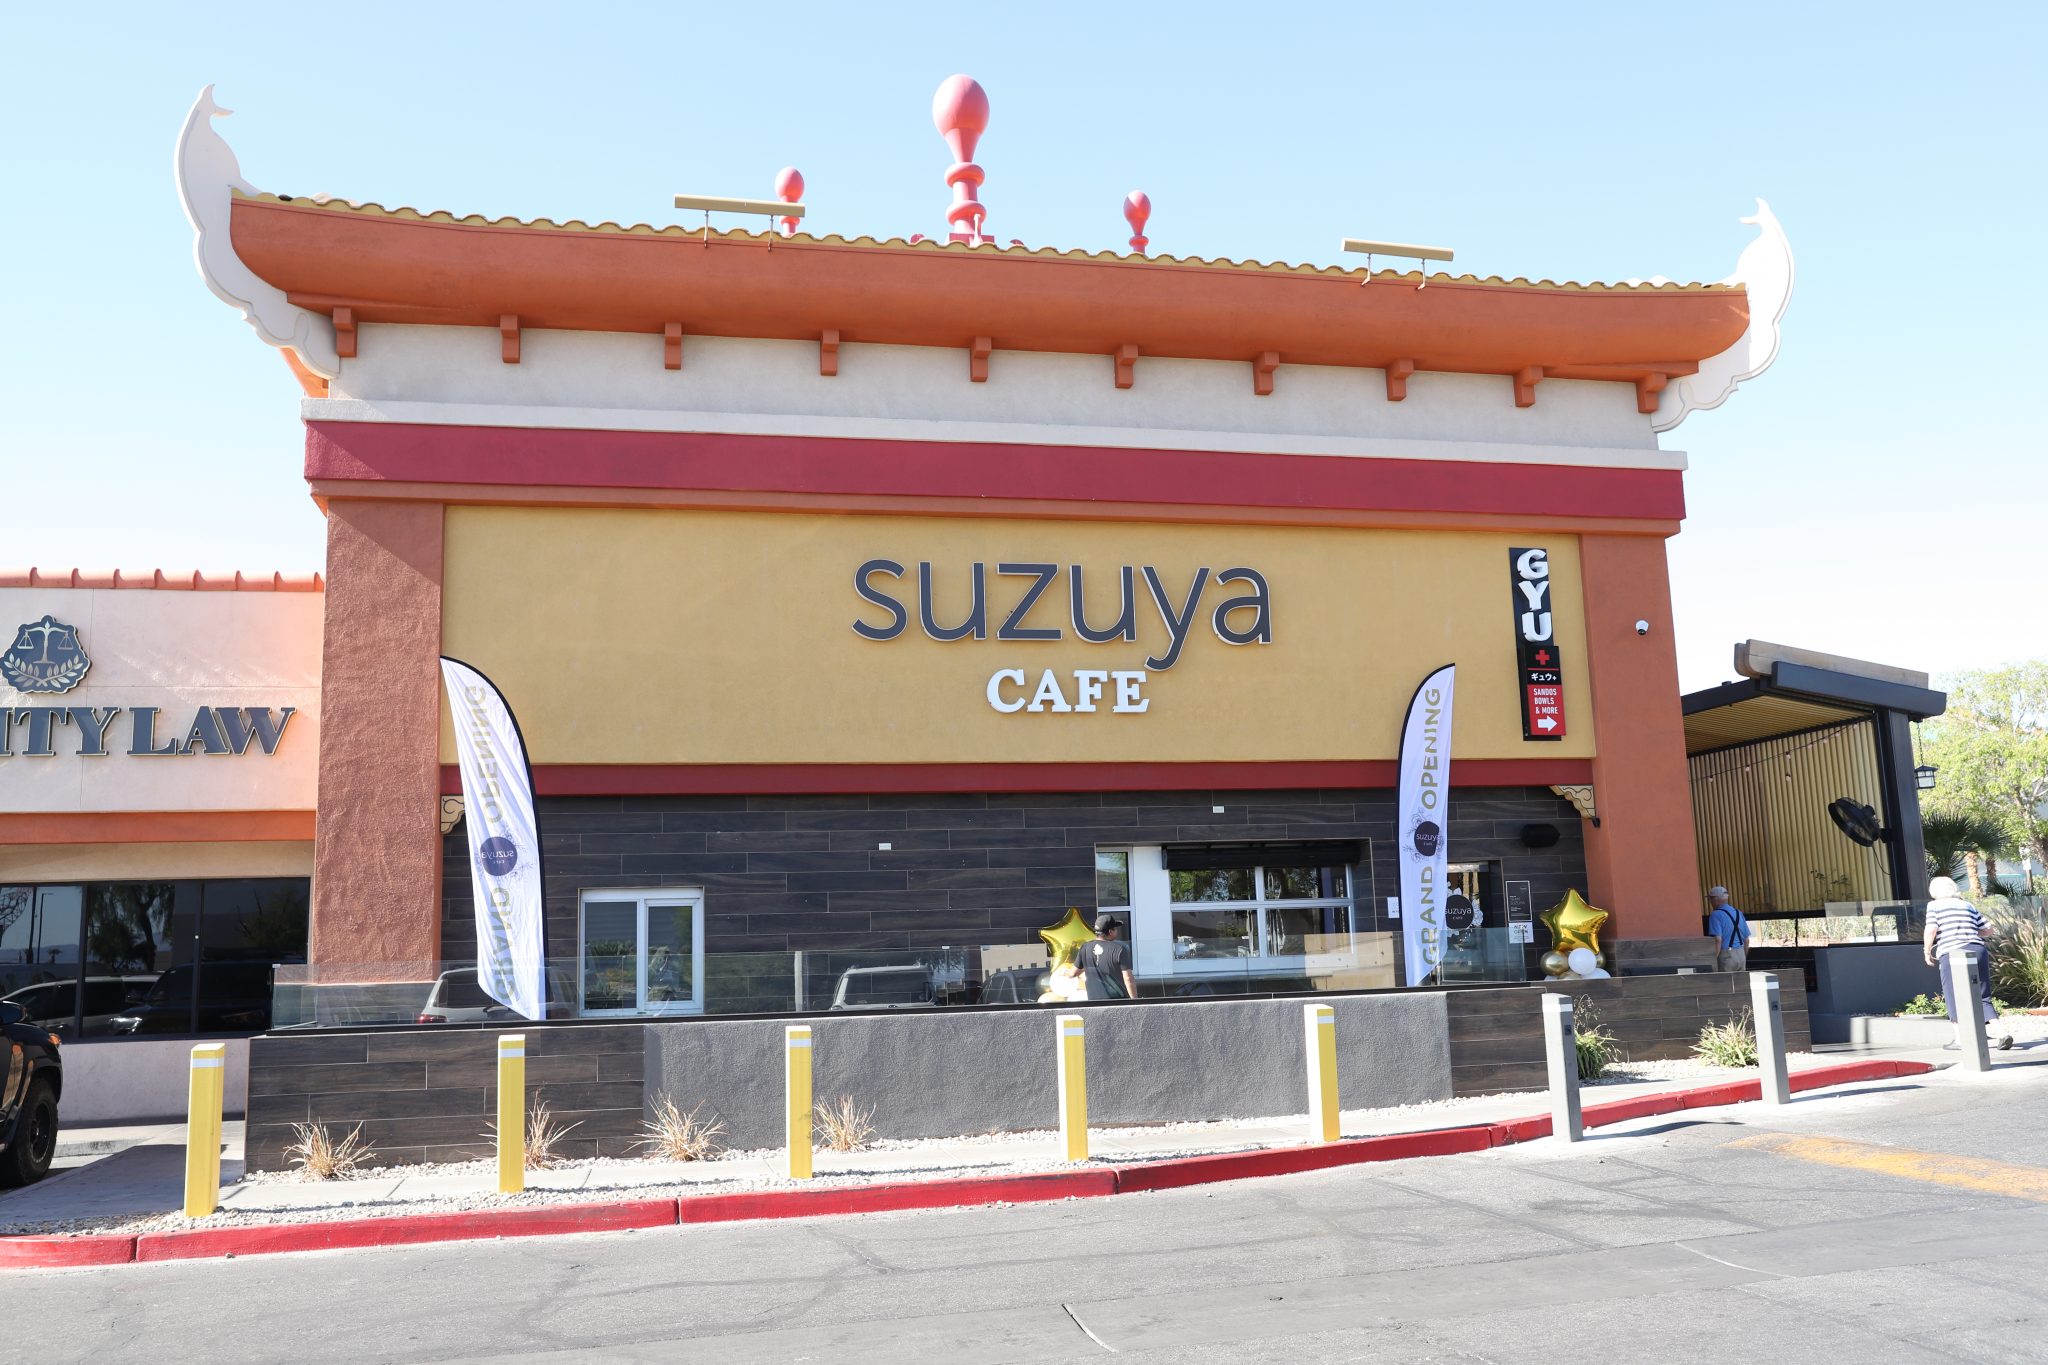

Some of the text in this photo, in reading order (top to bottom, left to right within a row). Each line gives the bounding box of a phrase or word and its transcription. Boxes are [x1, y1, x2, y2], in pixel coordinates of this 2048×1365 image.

[851, 558, 1273, 672] suzuya
[1517, 549, 1552, 642] GYU
[986, 668, 1150, 714] CAFE
[1533, 688, 1557, 696] SANDOS
[1534, 697, 1555, 705] BOWLS
[1535, 706, 1559, 714] & MORE
[127, 705, 297, 756] LAW
[1420, 688, 1441, 810] OPENING
[1420, 866, 1439, 965] GRAND
